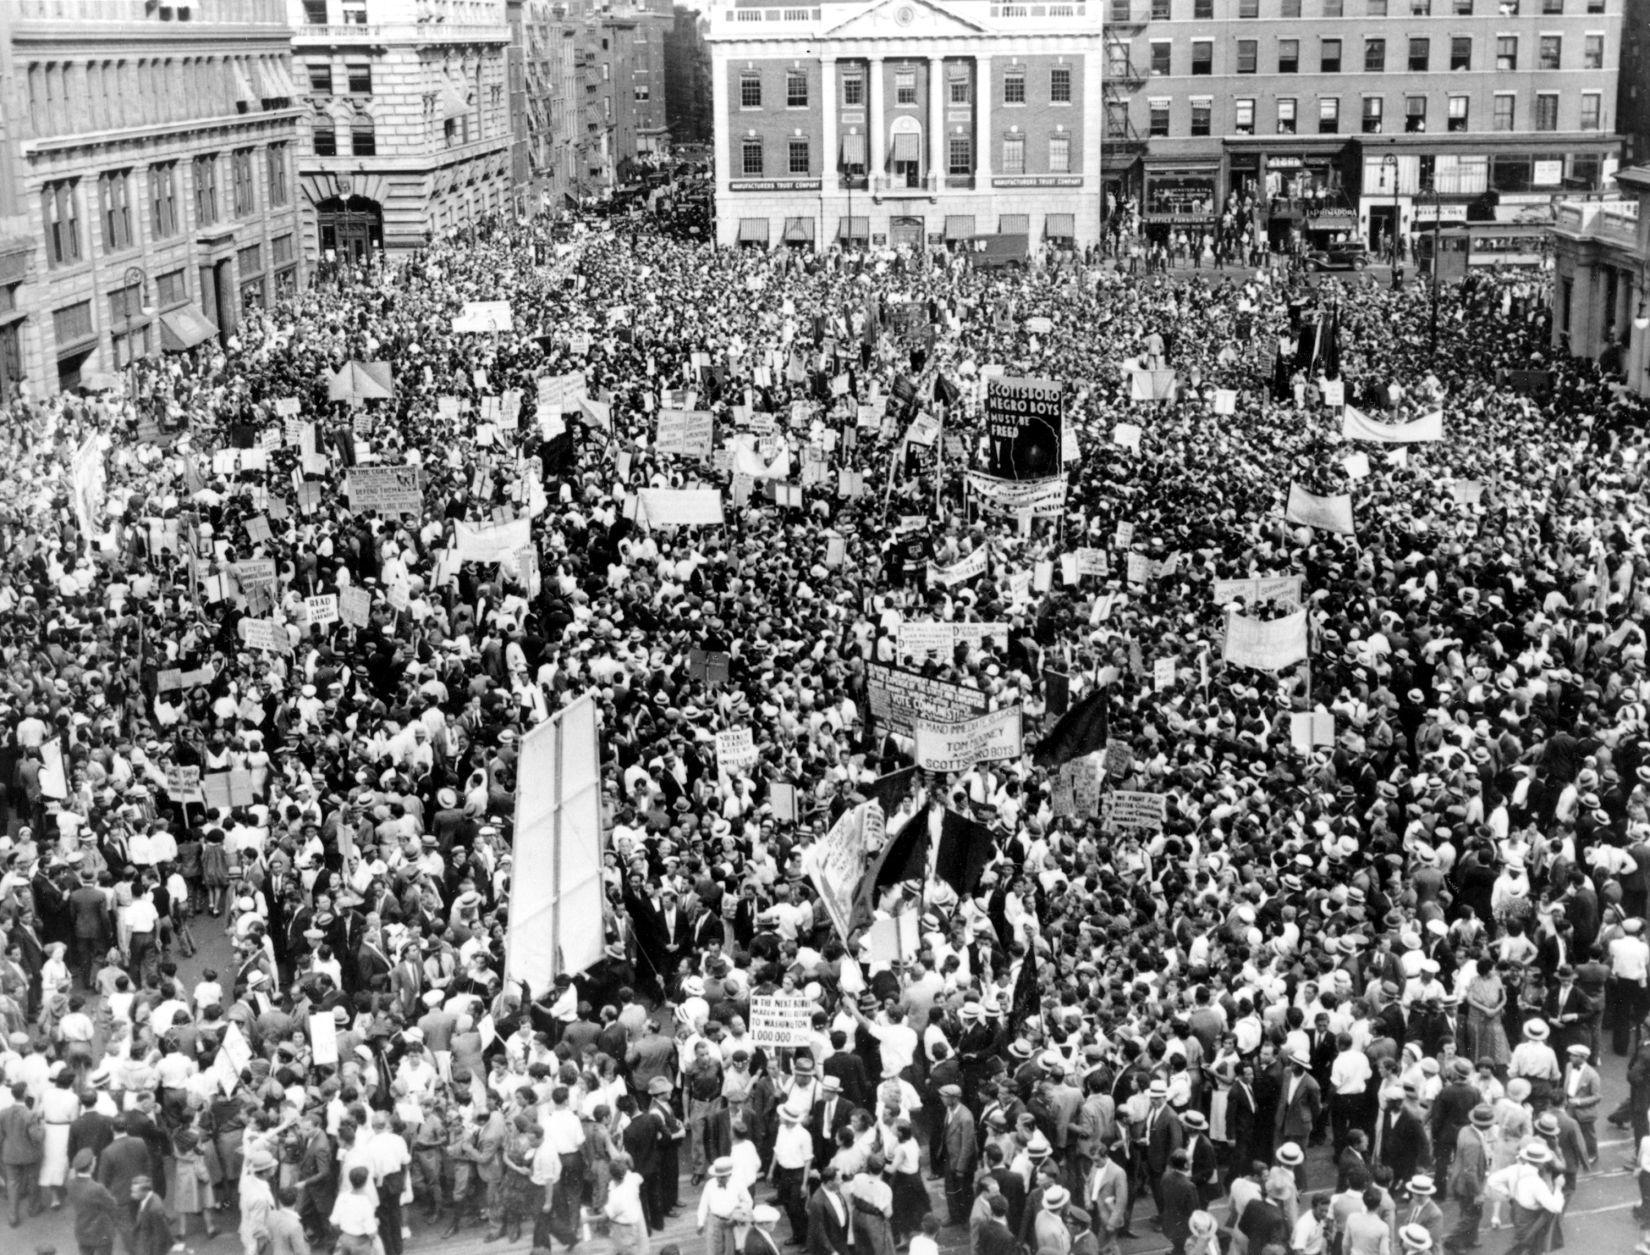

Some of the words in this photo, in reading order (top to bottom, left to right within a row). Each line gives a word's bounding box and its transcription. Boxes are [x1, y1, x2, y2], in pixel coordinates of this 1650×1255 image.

[989, 383, 1060, 402] SCOTTSBORO
[990, 397, 1027, 412] NEGRO
[1030, 401, 1059, 416] BOYS
[991, 413, 1016, 424] MUST
[1019, 416, 1030, 426] BE
[991, 424, 1019, 438] FREED
[309, 597, 331, 607] READ
[891, 692, 911, 707] VOTE
[947, 741, 966, 752] TOM
[925, 747, 990, 770] SCOTTSBORO
[991, 745, 1014, 757] BOYS
[775, 999, 791, 1008] NEXT
[752, 1018, 760, 1026] TO
[764, 1020, 807, 1028] WASHINGTON
